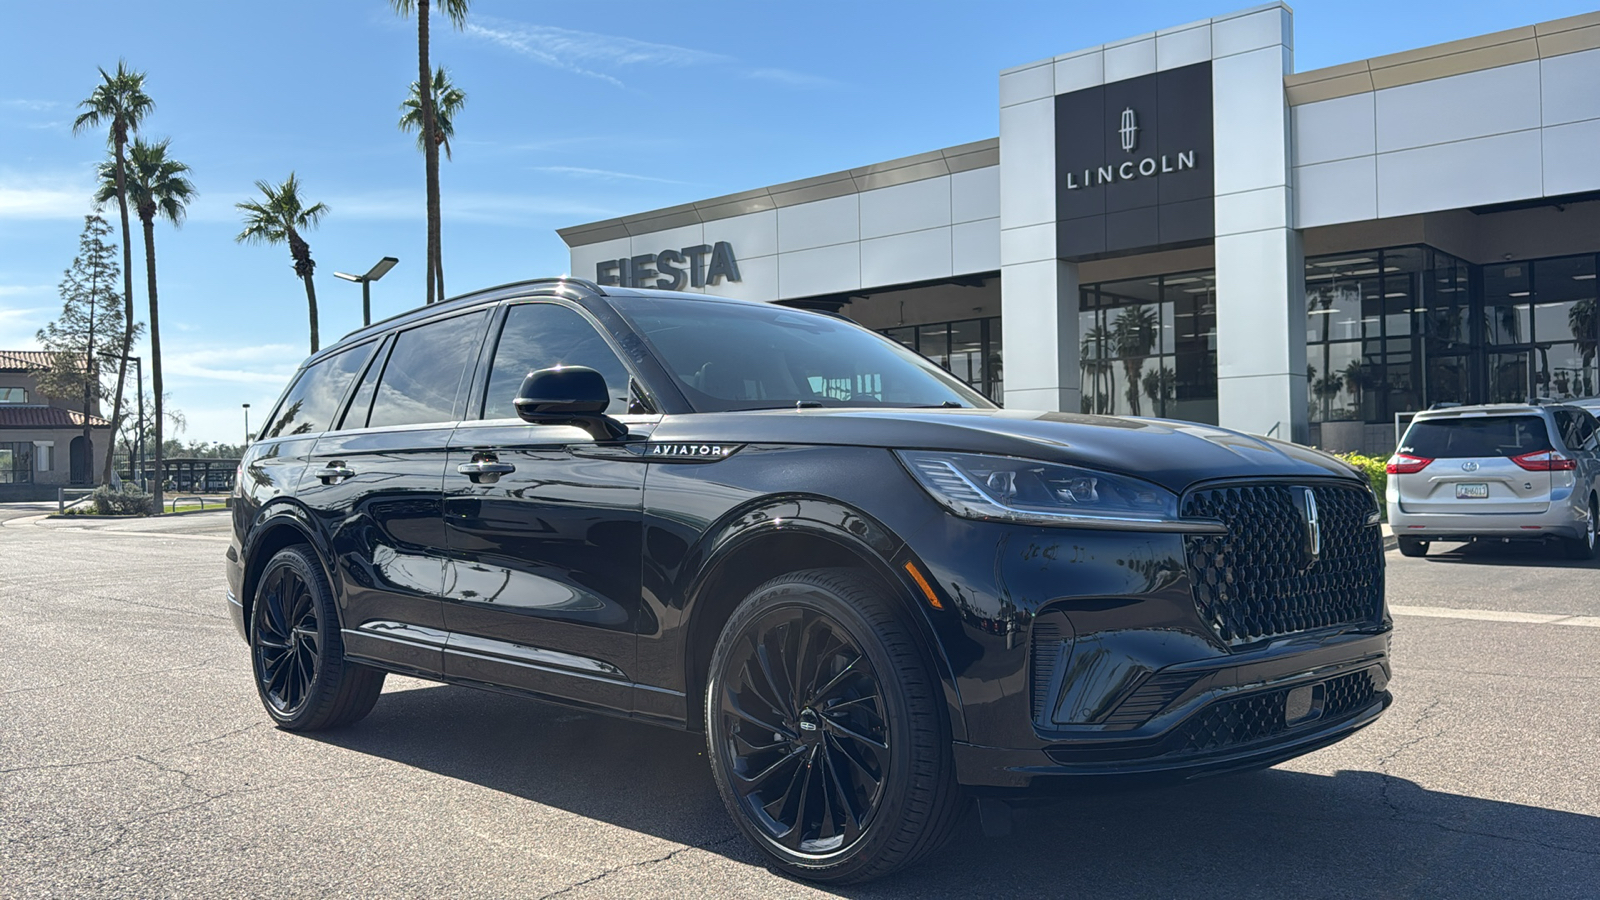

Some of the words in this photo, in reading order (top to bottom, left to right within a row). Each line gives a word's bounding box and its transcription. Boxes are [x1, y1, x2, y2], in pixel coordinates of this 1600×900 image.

[1067, 150, 1195, 189] LINCOLN
[596, 241, 742, 290] FIESTA
[653, 445, 721, 455] AVIATOR
